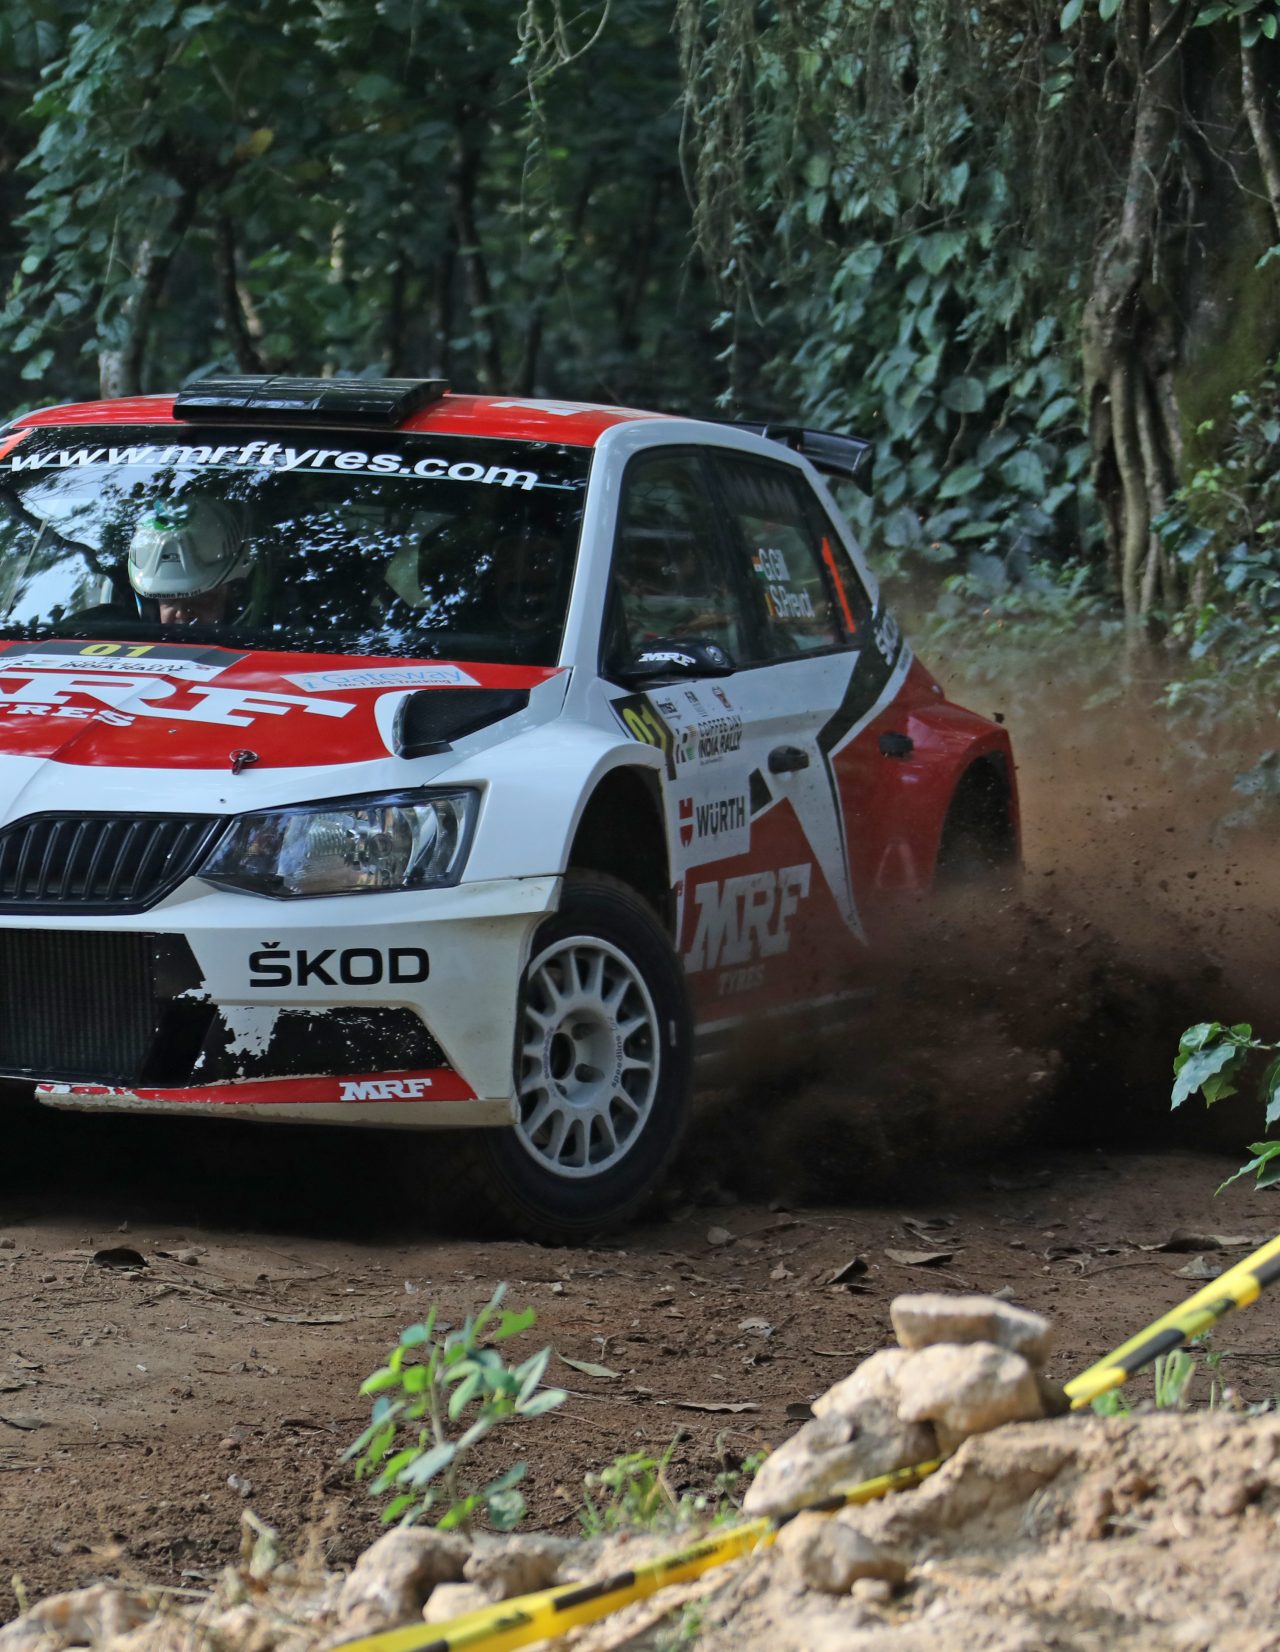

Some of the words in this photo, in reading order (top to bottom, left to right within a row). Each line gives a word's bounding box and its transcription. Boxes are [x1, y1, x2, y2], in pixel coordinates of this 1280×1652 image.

[11, 440, 539, 491] www.mrftyres.com
[79, 643, 156, 658] 01
[638, 652, 697, 667] MRF
[683, 863, 812, 975] MRF
[248, 941, 430, 988] ŠKOD
[338, 1078, 432, 1101] MRF
